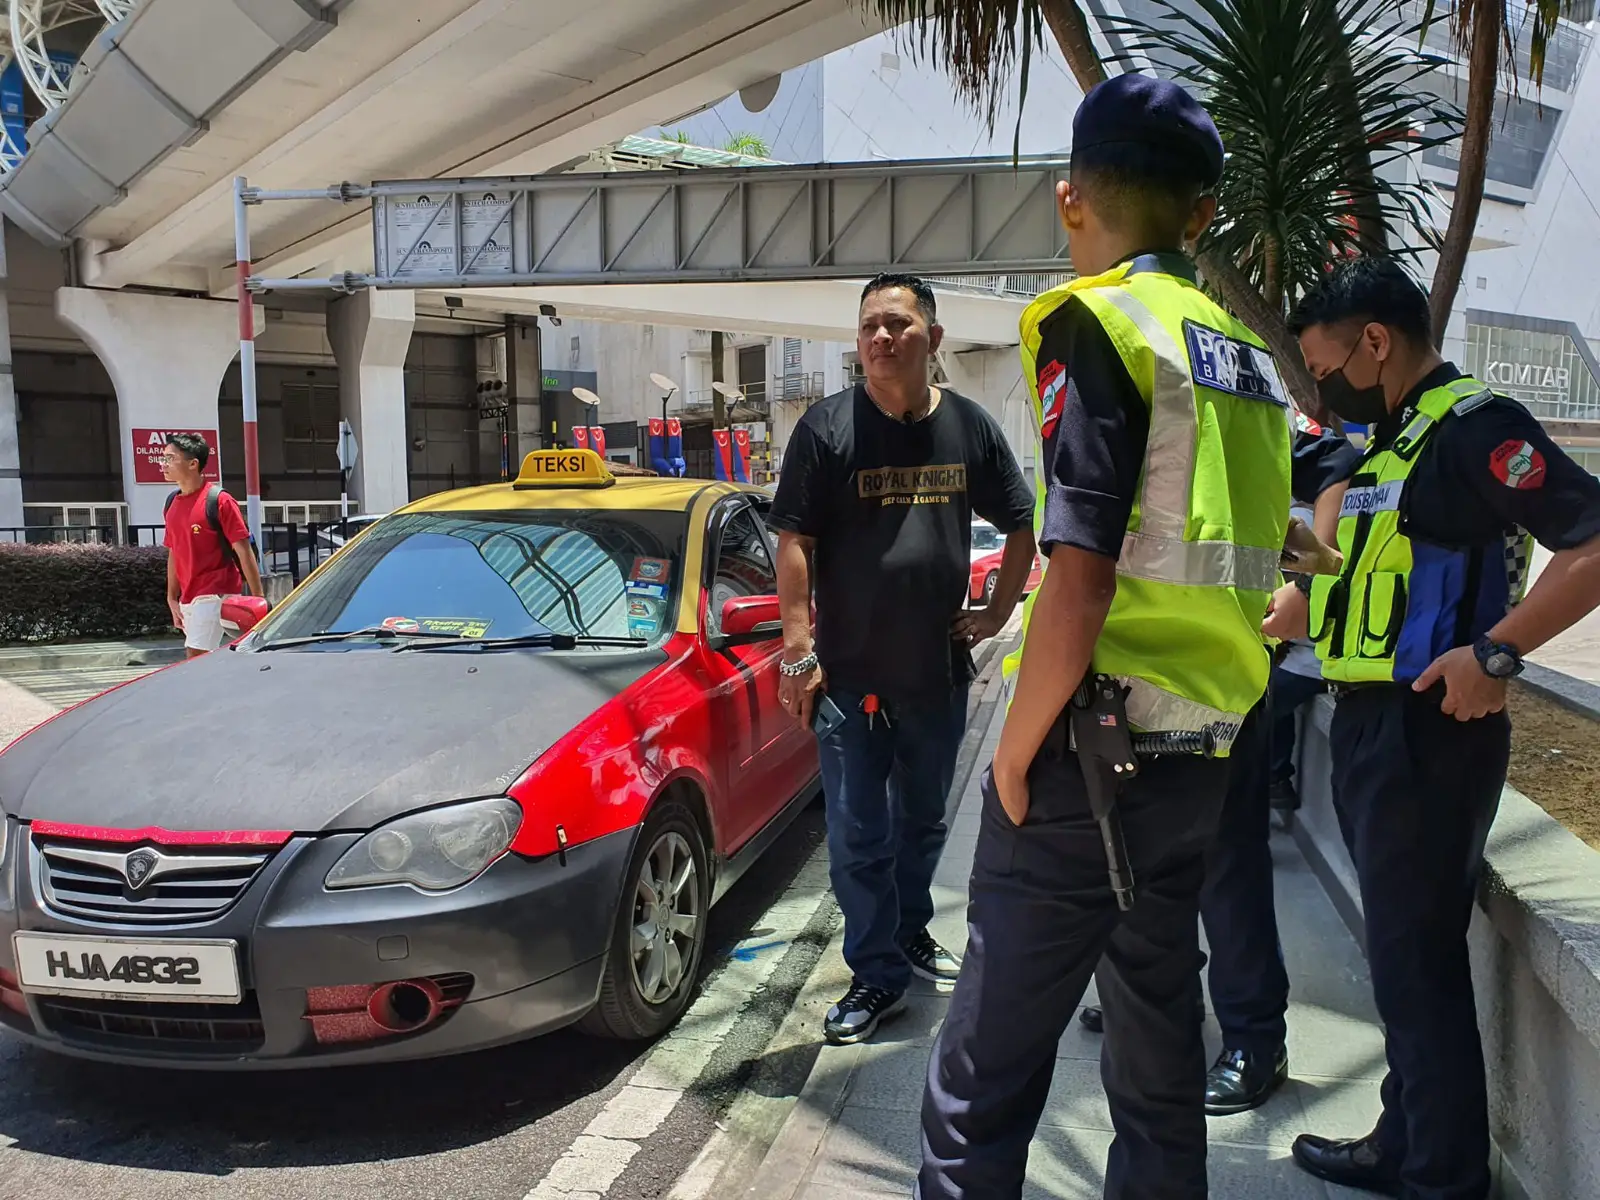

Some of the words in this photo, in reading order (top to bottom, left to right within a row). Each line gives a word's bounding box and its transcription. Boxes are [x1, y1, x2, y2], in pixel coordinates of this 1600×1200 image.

[1484, 361, 1569, 388] KOMTAR
[533, 456, 585, 473] TEKSI
[863, 471, 908, 491] ROYAL
[912, 469, 965, 489] KNIGHT
[882, 497, 896, 507] KEEP
[896, 496, 911, 504] CALM
[920, 496, 940, 504] GAME
[940, 495, 950, 503] ON
[46, 950, 202, 985] HJA4832
